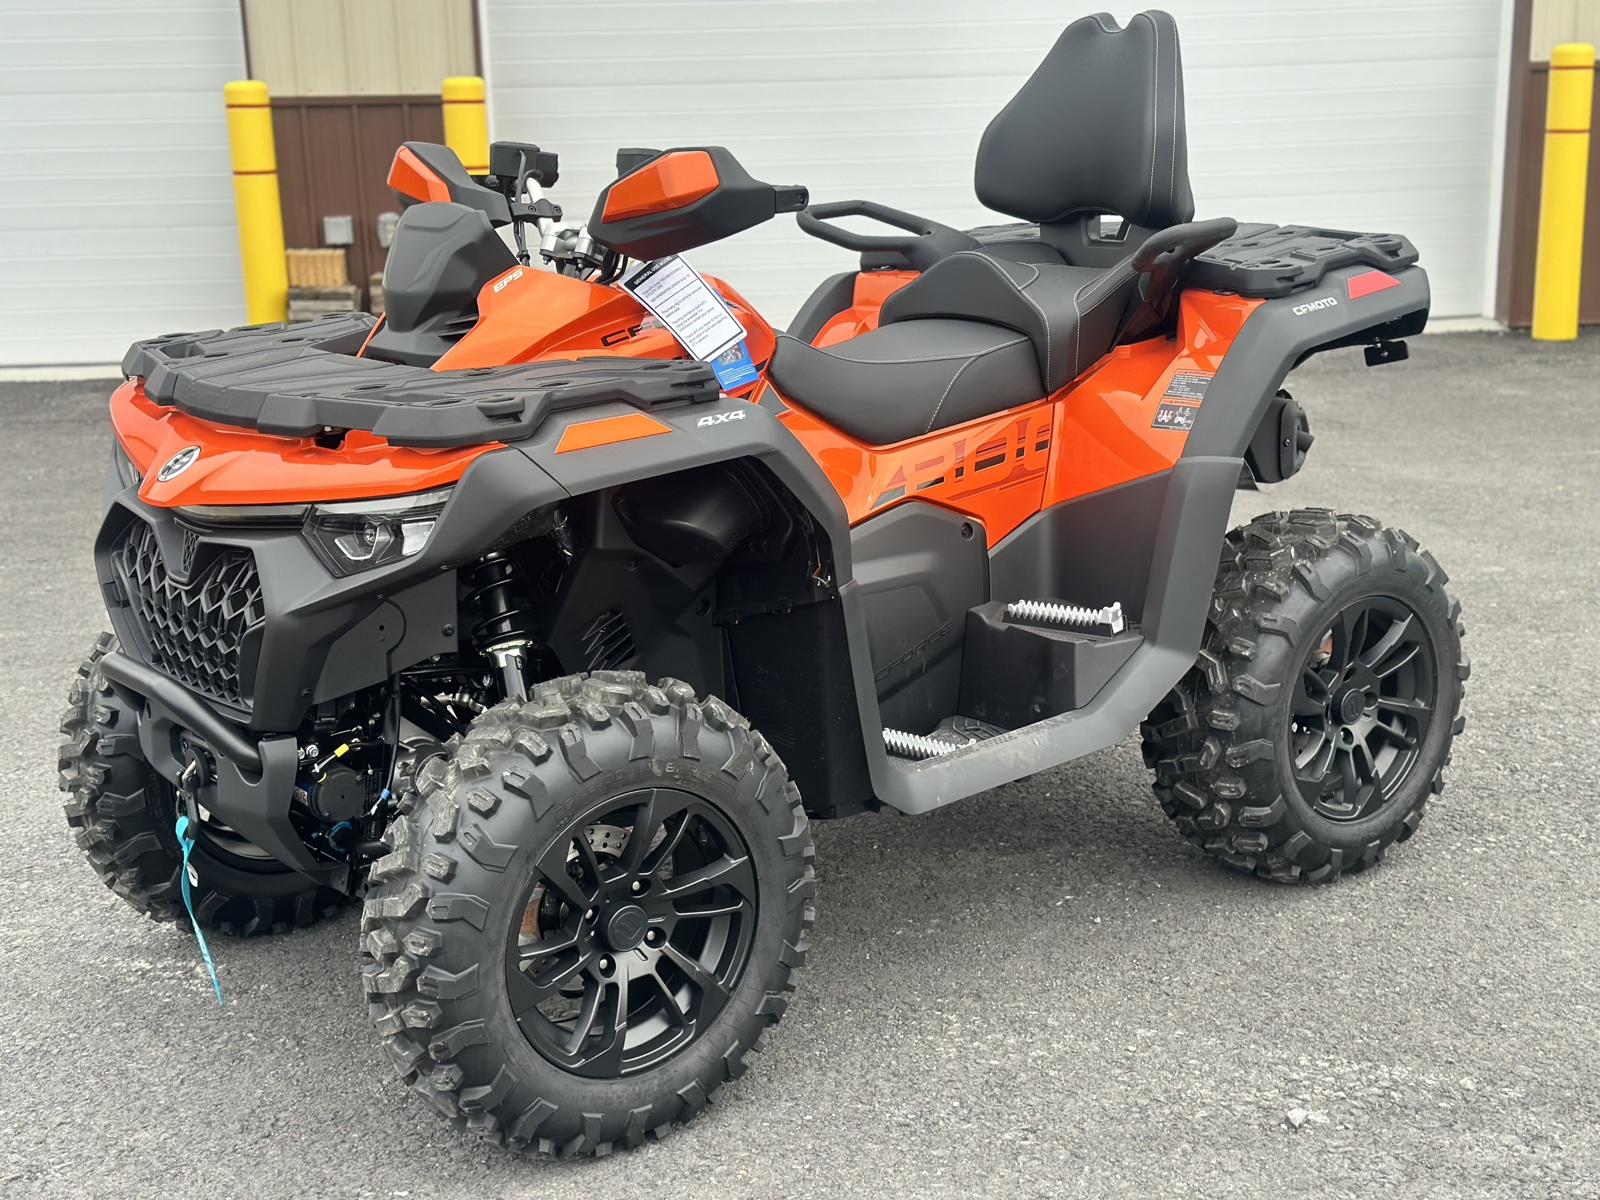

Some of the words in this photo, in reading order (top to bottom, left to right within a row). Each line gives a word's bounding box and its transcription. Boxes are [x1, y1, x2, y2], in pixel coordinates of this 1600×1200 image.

[493, 268, 524, 294] EPS
[633, 269, 652, 285] GENERAL
[650, 263, 660, 271] USE
[1292, 296, 1338, 316] CFMOTO
